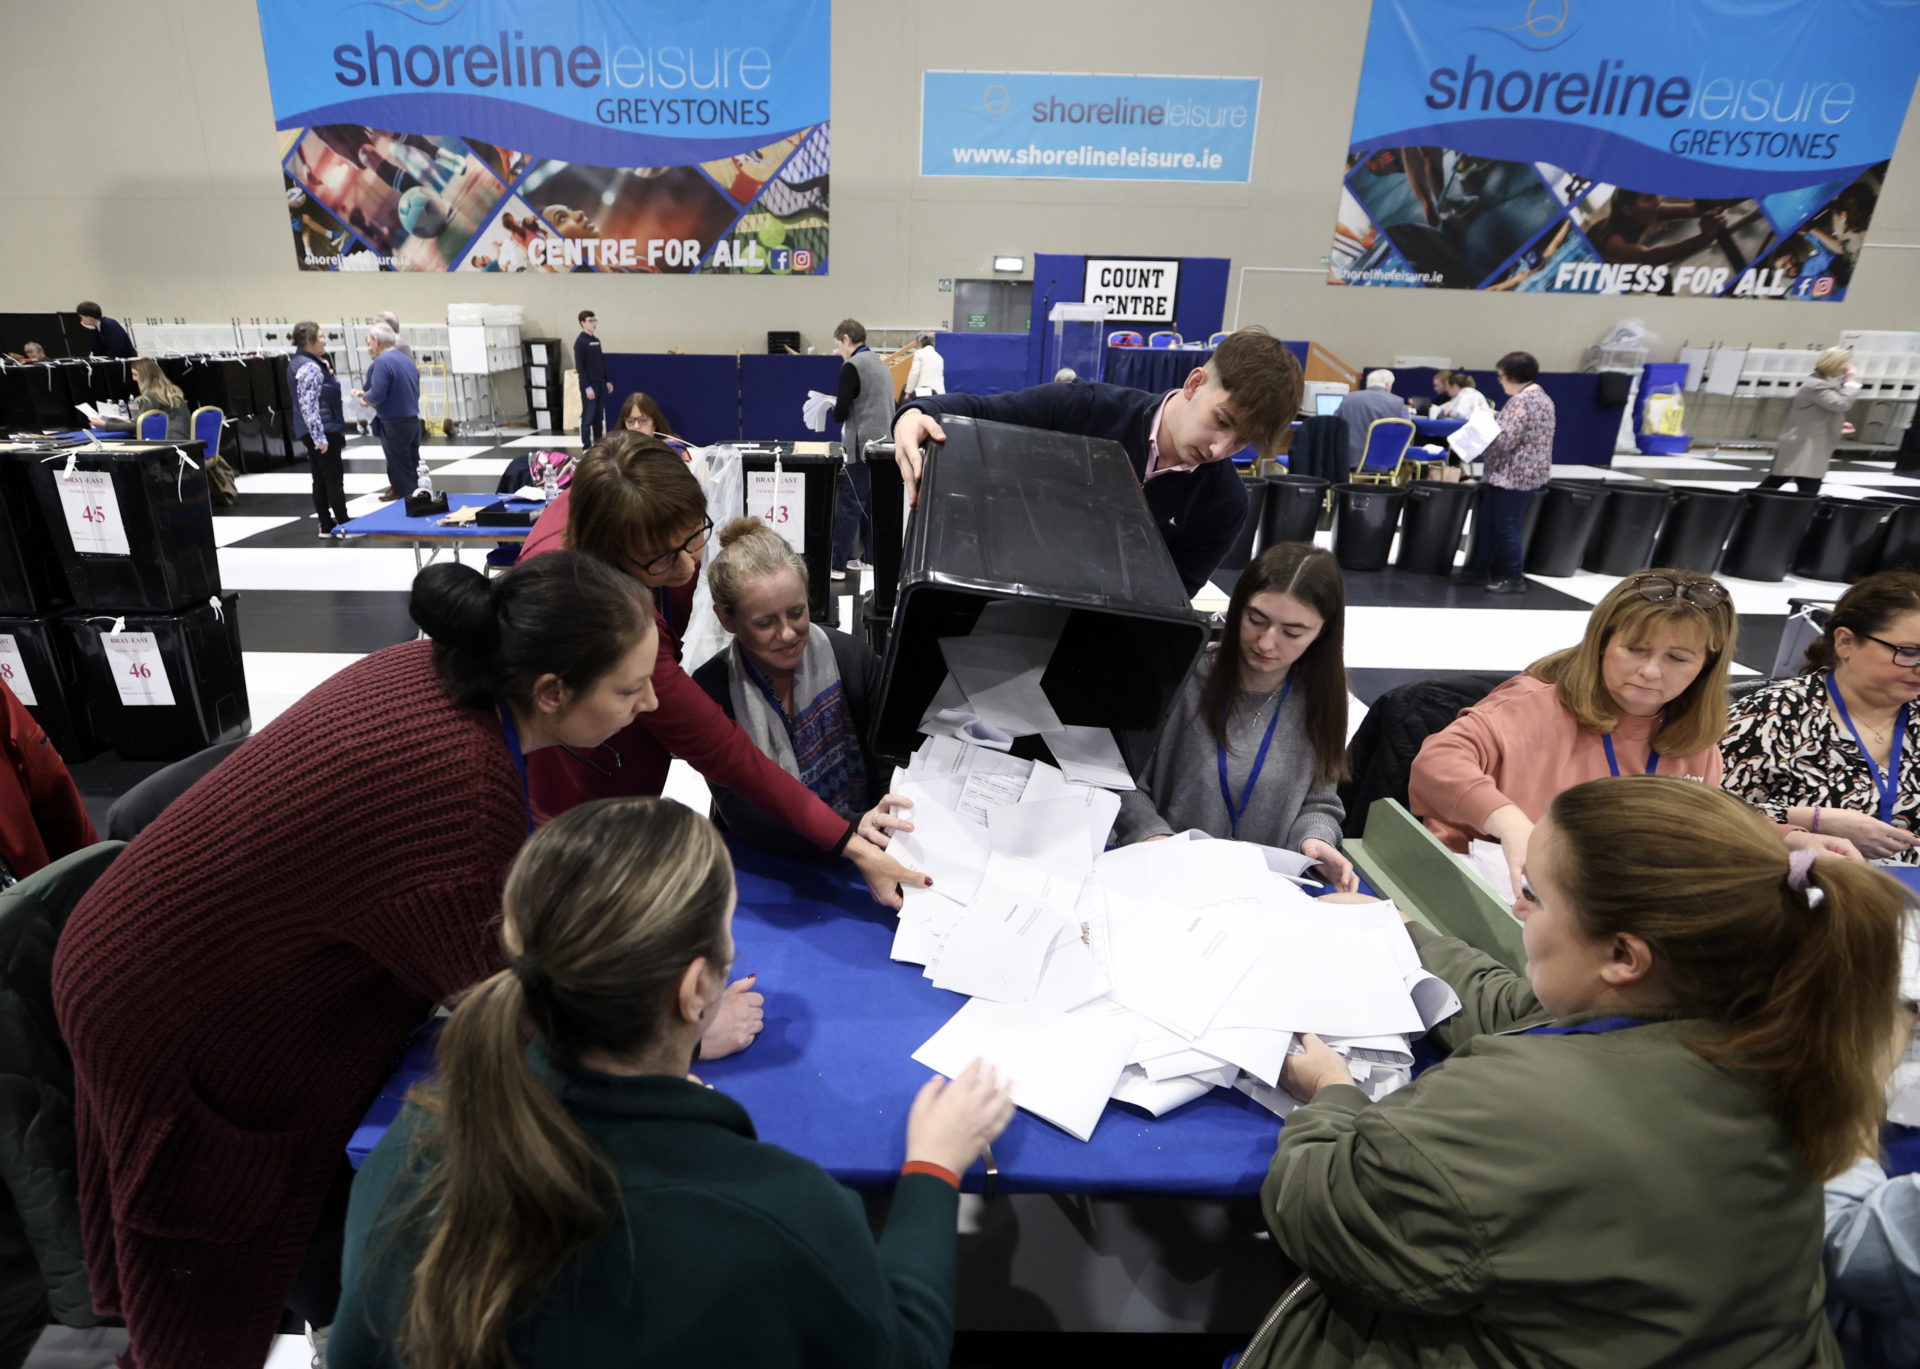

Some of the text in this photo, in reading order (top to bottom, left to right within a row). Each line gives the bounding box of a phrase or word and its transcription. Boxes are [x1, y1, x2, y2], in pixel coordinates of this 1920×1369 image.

[596, 98, 770, 126] GREYSTONES
[1669, 128, 1840, 161] GREYSTONES
[952, 144, 1224, 170] www.shorelineleisure.ie
[528, 238, 637, 268] CENTRE
[648, 238, 701, 268] FOR
[712, 239, 764, 268] ALL
[1100, 267, 1165, 289] COUNT
[1554, 262, 1785, 296] FITNESS FOR ALL
[82, 505, 105, 523] 45
[765, 505, 789, 524] 43
[0, 663, 14, 679] 8
[129, 662, 151, 679] 46
